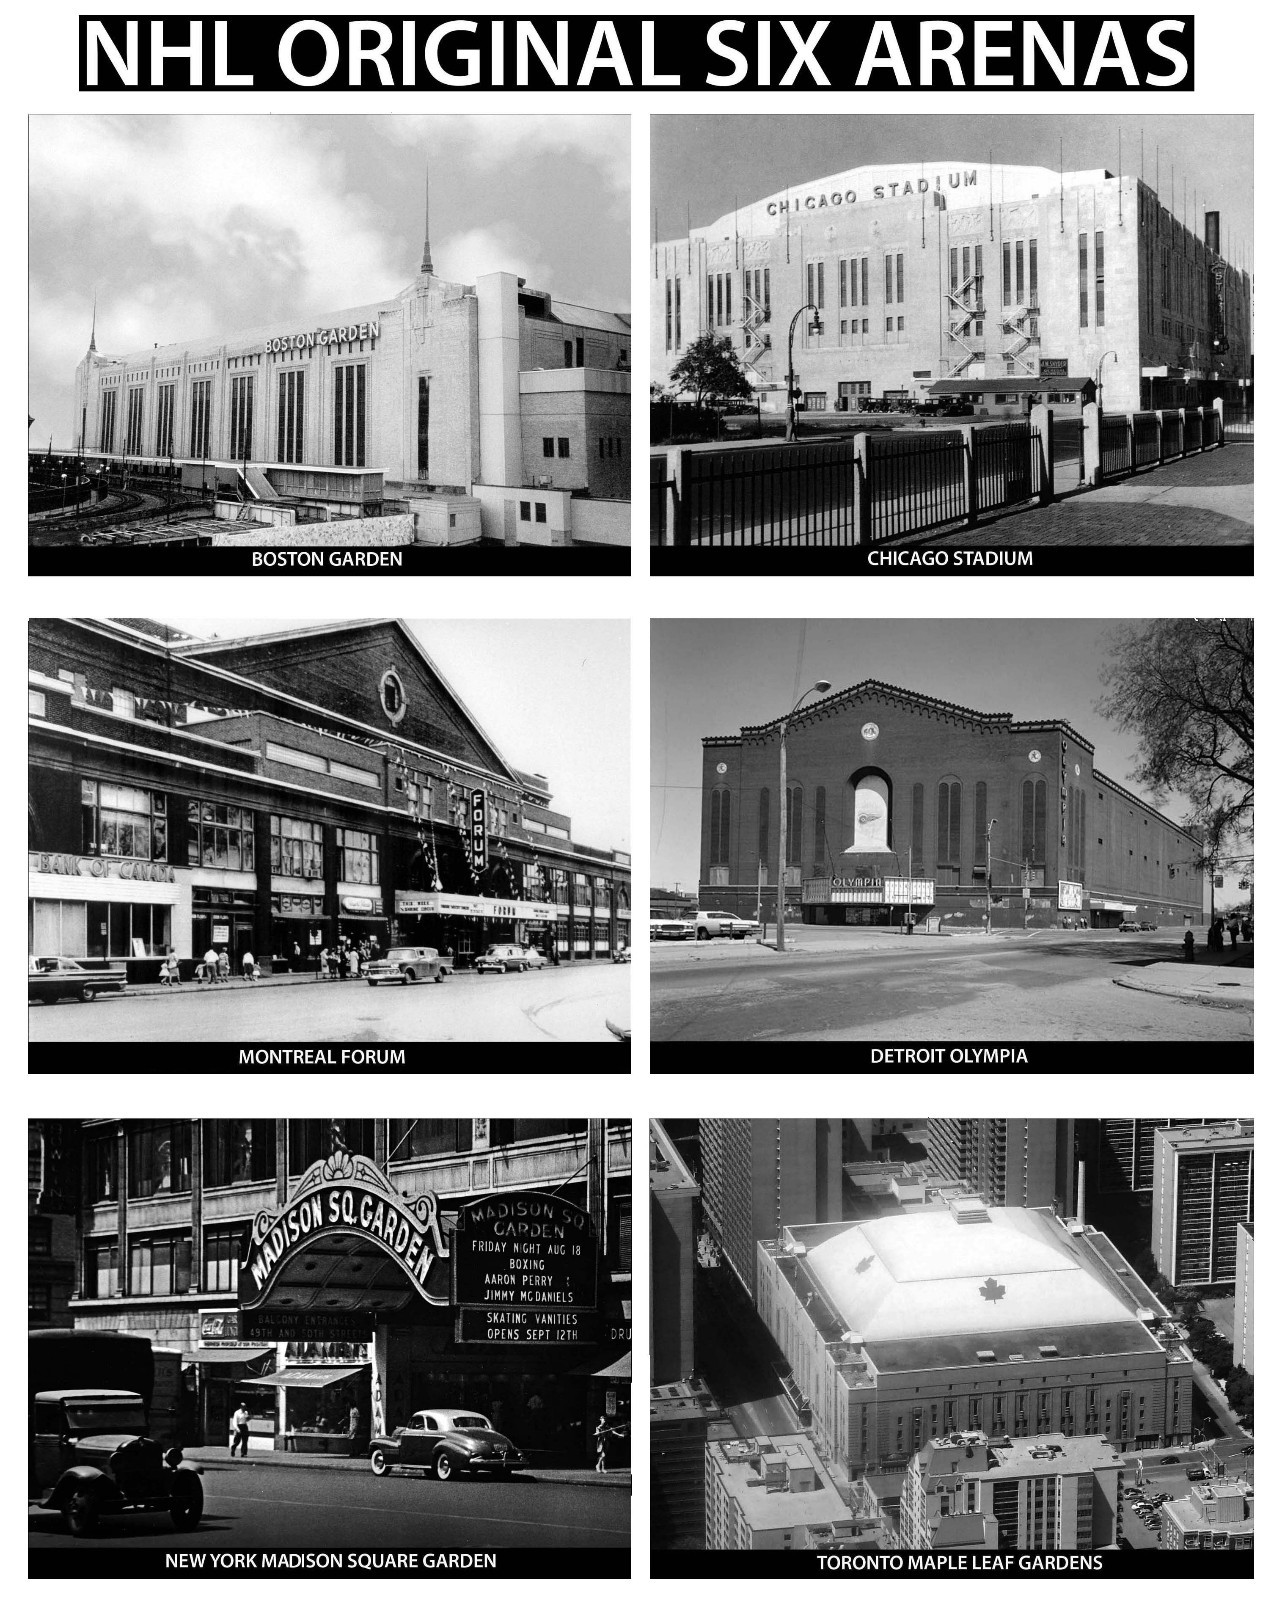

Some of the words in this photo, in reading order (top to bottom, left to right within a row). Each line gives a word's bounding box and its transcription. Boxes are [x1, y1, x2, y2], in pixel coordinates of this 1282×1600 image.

[766, 190, 857, 216] CHICAGO
[873, 170, 977, 200] STADIUM
[265, 332, 315, 353] BOSTON
[319, 321, 379, 346] GARDEN
[1060, 740, 1069, 848] OLYMPIA
[472, 794, 485, 868] FORUM
[38, 853, 81, 876] BANK
[90, 859, 112, 878] OF
[119, 861, 176, 883] CANADA
[832, 877, 882, 887] OLYMPIA
[471, 1202, 554, 1222] MADISON
[562, 1209, 585, 1230] SQ
[493, 1221, 565, 1239] GARDEN
[251, 1194, 323, 1290] MADISON
[328, 1190, 358, 1225] SQ.
[360, 1194, 435, 1285] GARDEN
[472, 1240, 507, 1253] FRIDAY
[513, 1242, 541, 1254] NIGHT
[547, 1244, 566, 1256] AUG
[572, 1245, 581, 1256] 18
[509, 1258, 545, 1270] BOXING
[484, 1273, 516, 1285] AARON
[522, 1274, 553, 1287] PERRY
[484, 1289, 515, 1301] JIMMY
[257, 1314, 299, 1325] BALCONY
[486, 1312, 527, 1324] SKATING
[535, 1313, 578, 1325] VANITIES
[249, 1328, 273, 1338] 49TH
[278, 1328, 296, 1339] AND
[302, 1328, 325, 1339] 50TH
[487, 1328, 520, 1340] OPENS
[526, 1329, 551, 1341] SEPT
[556, 1329, 578, 1341] 12TH
